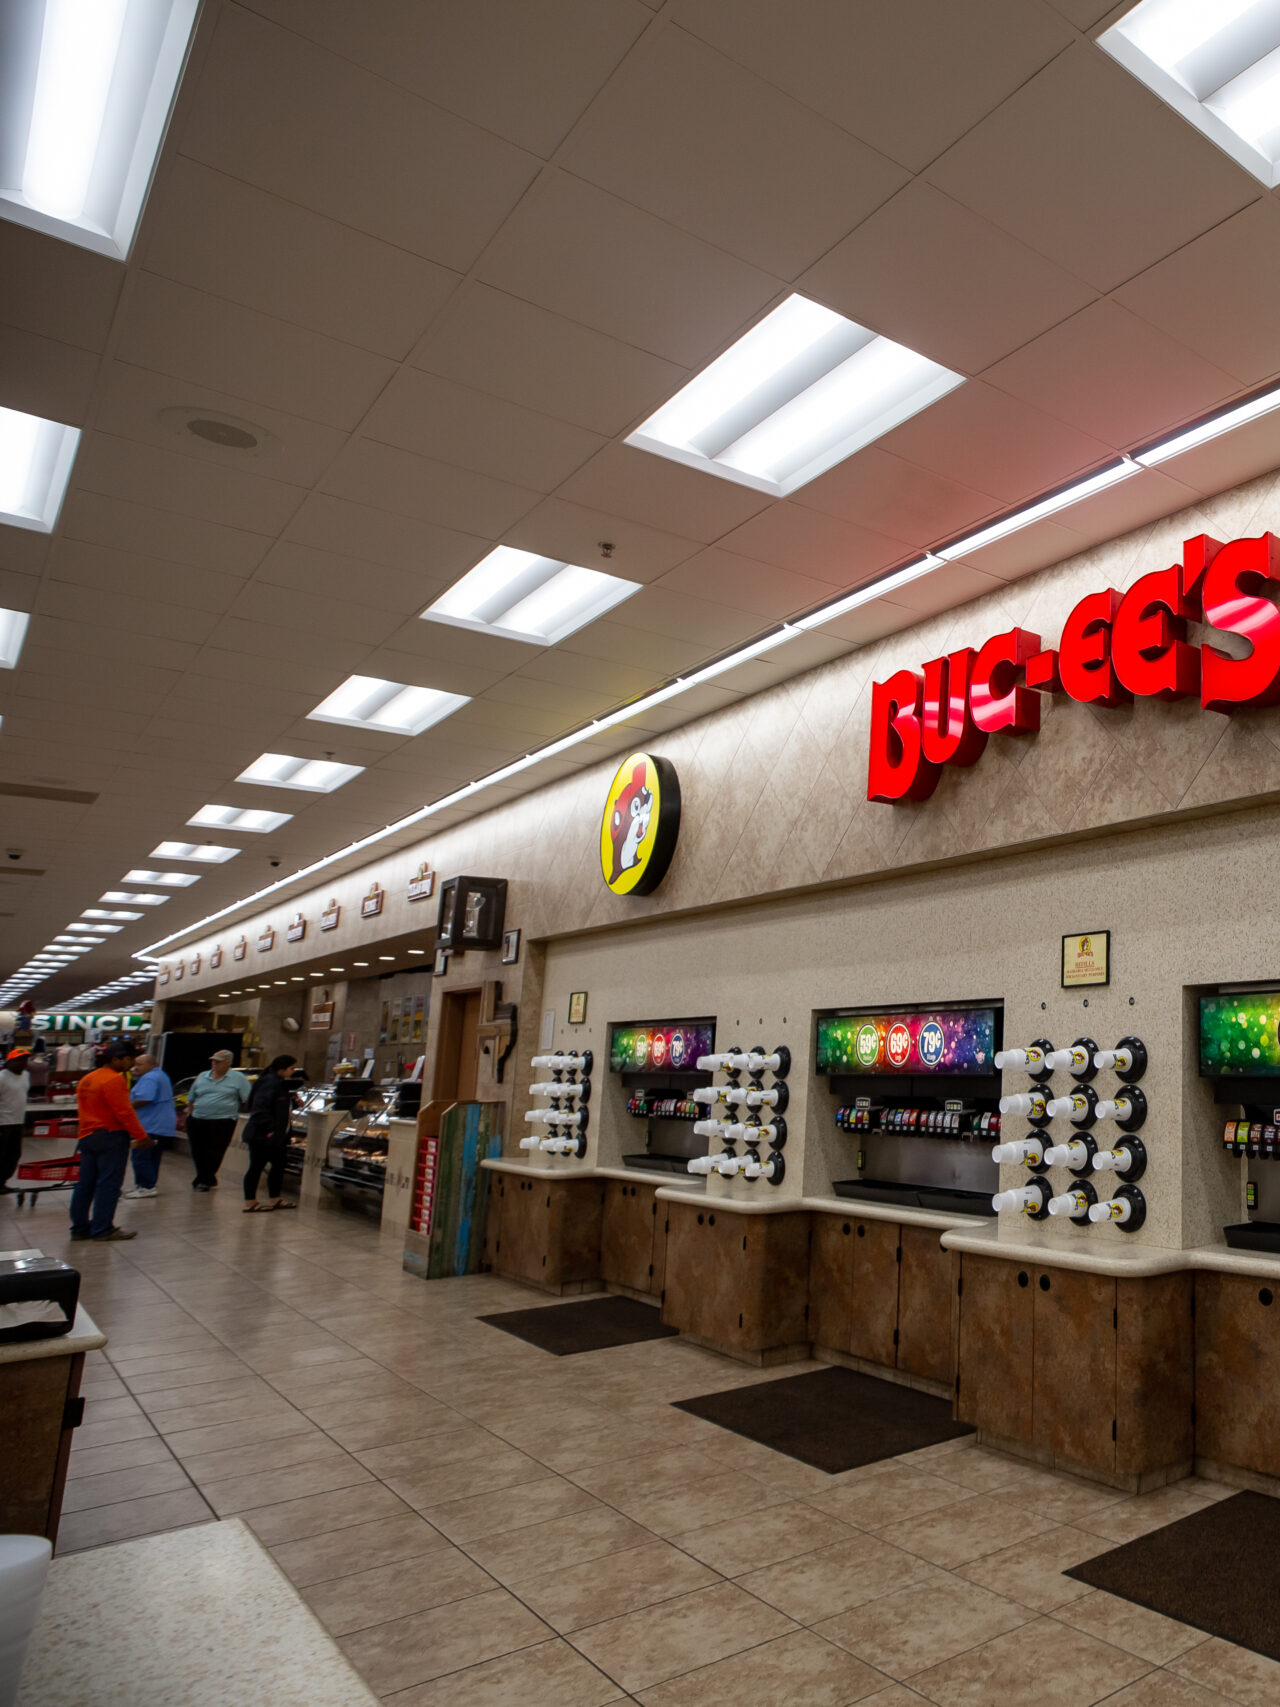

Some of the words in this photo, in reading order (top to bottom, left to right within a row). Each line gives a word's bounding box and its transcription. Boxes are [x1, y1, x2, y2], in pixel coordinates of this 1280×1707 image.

[860, 1033, 876, 1054] 59¢
[890, 1031, 908, 1054] 69¢
[923, 1030, 941, 1053] 79¢
